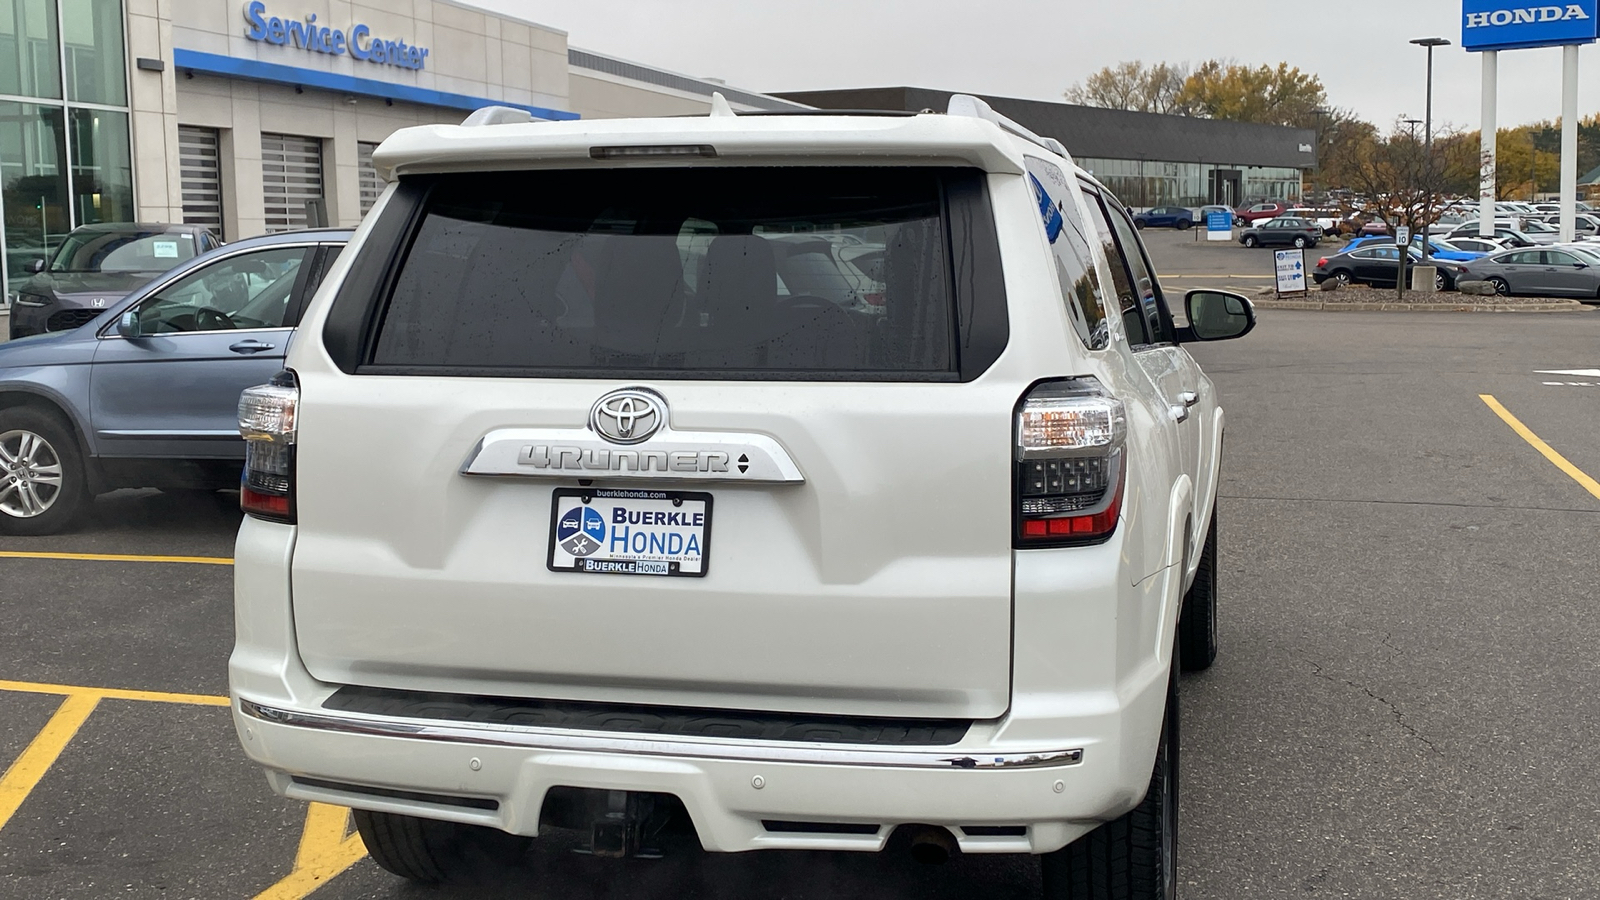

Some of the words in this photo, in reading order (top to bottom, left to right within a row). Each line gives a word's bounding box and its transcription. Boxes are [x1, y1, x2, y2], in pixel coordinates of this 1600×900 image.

[1466, 4, 1589, 28] HONDA
[244, 1, 345, 55] Service
[348, 24, 429, 70] Center
[517, 445, 729, 473] 4RUNNER
[597, 489, 667, 499] buerklehonda.com
[612, 507, 703, 527] BUERKLE
[610, 525, 701, 556] HONDA
[586, 560, 636, 573] BUERKLE
[636, 561, 667, 573] HONDA
